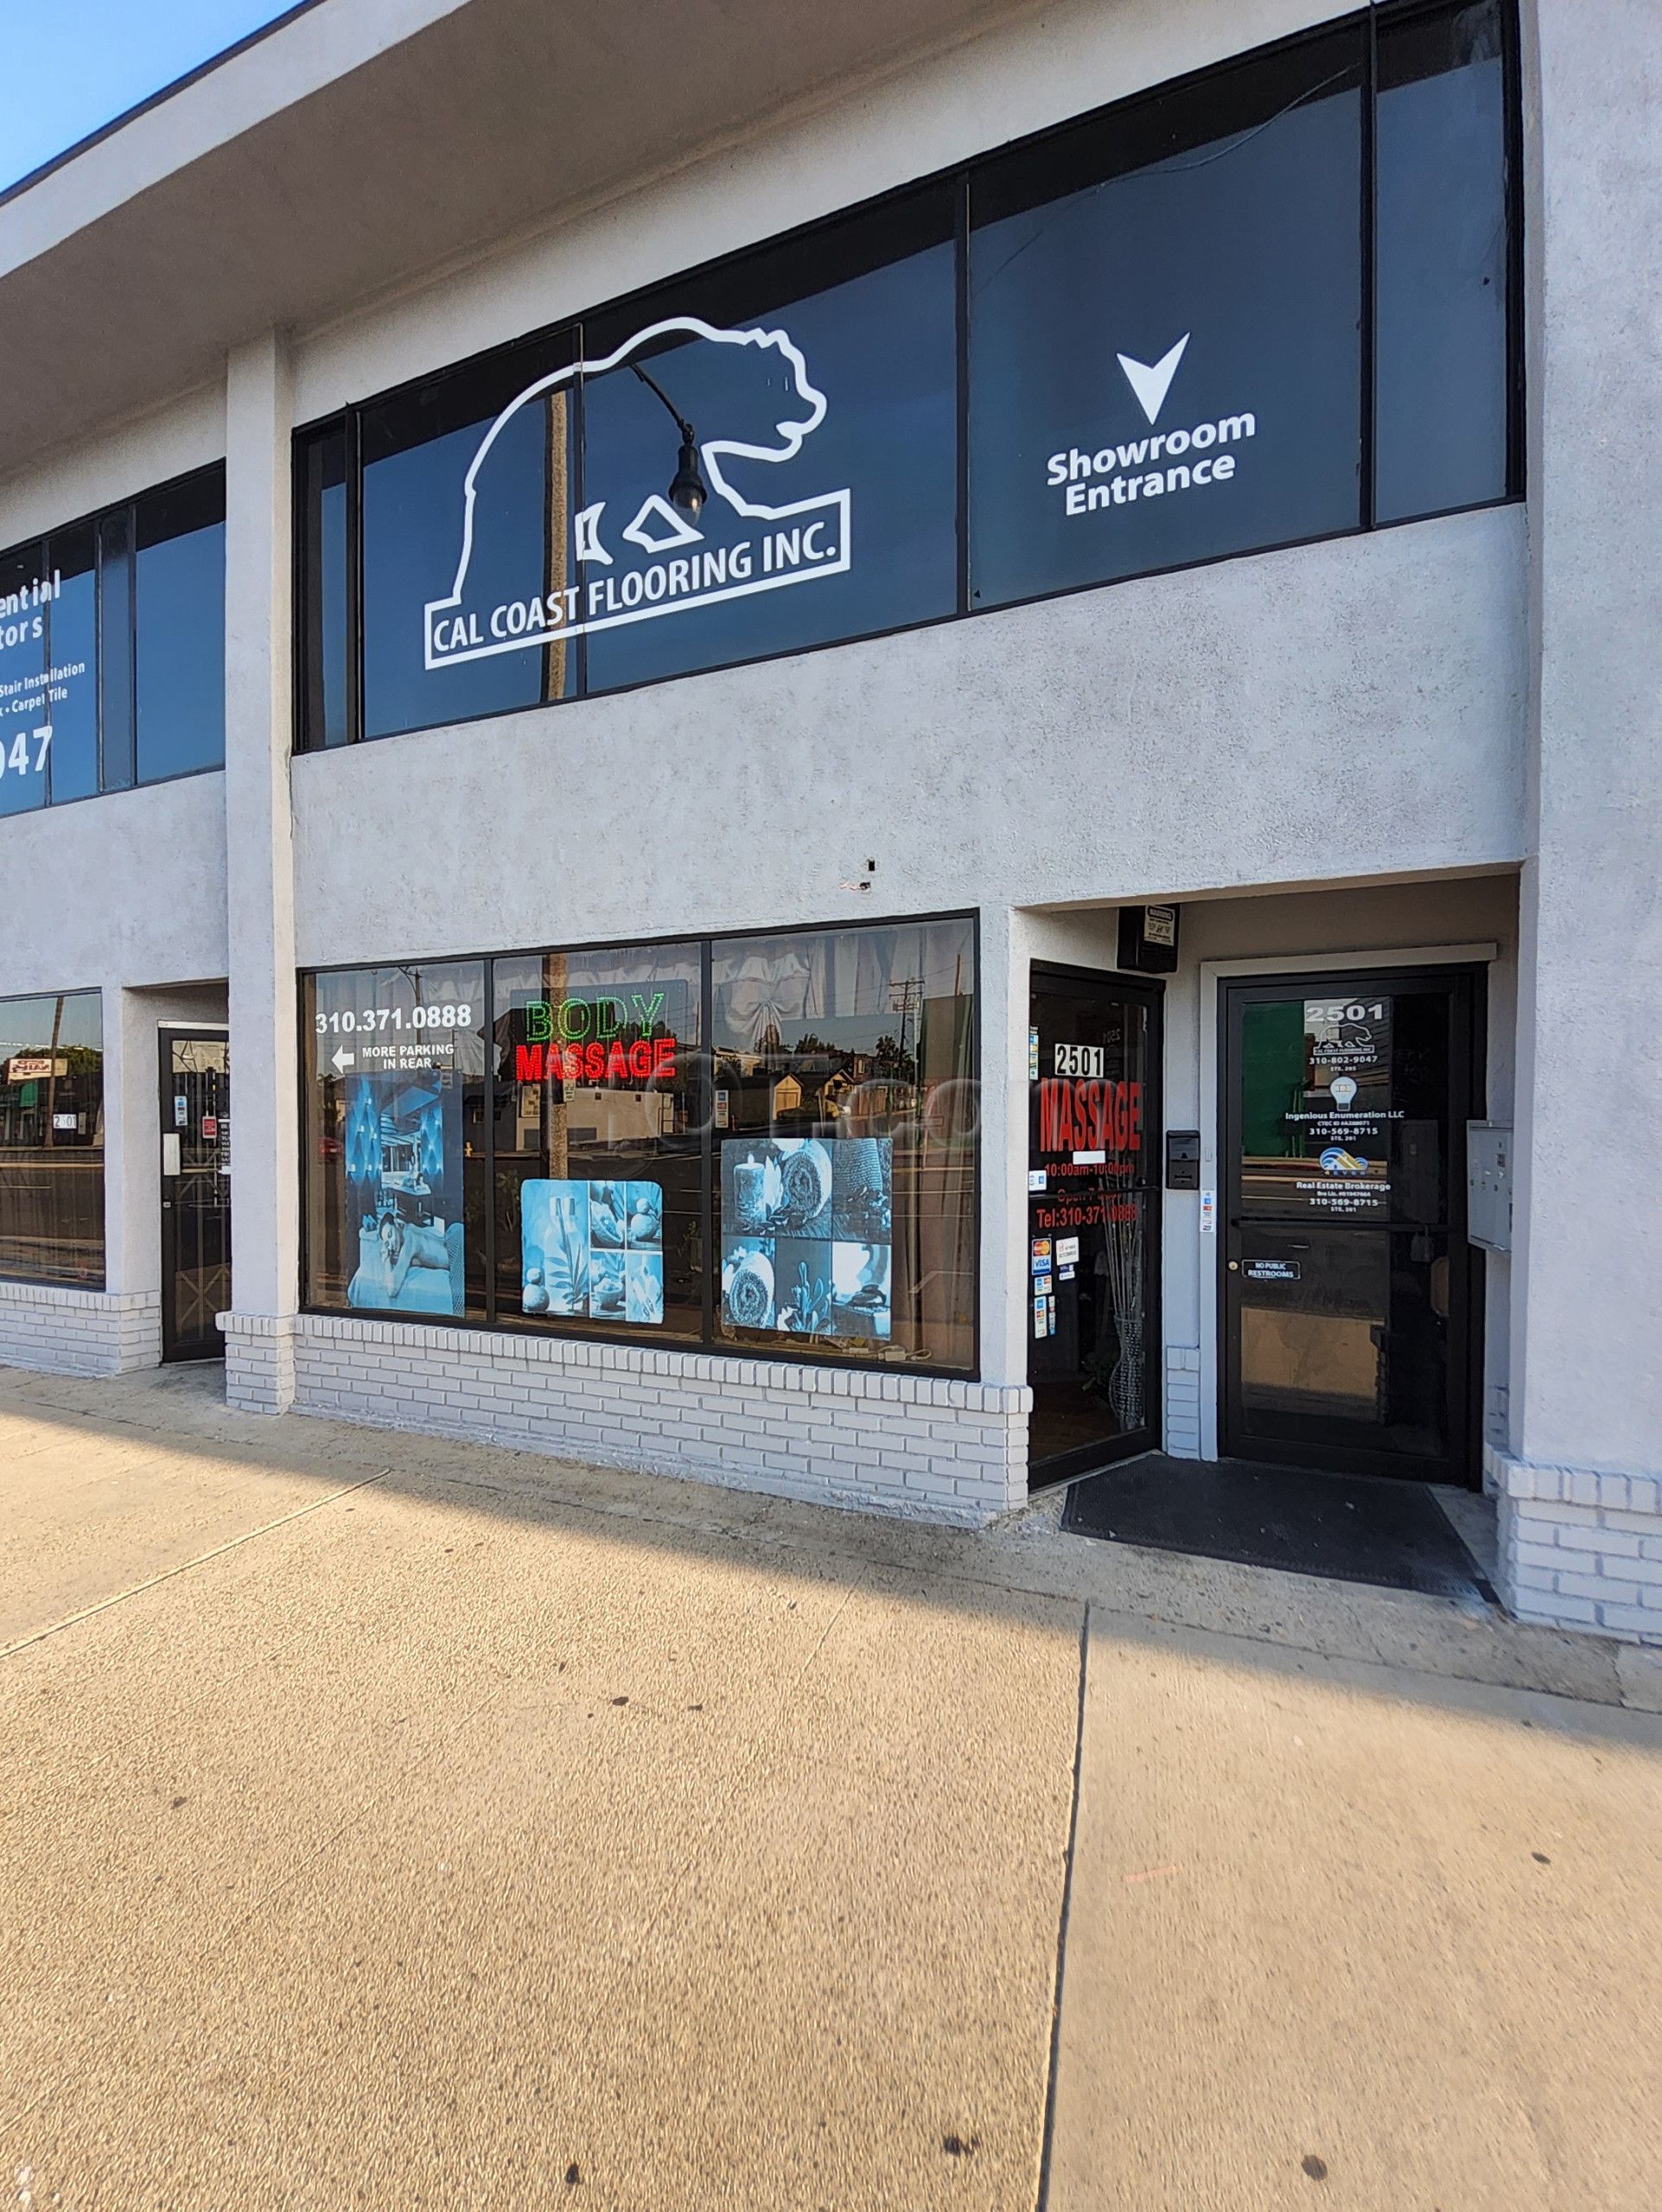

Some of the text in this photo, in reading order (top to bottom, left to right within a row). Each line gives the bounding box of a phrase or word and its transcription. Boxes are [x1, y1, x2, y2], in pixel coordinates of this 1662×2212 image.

[1047, 412, 1256, 486] Showroom
[1066, 454, 1236, 516] Entrance
[433, 521, 837, 652] CAL COAST FLOORING INC.
[24, 662, 86, 690] Installation
[48, 686, 68, 702] Tile
[0, 725, 53, 779] 47
[315, 1004, 472, 1034] 310.371.0888
[525, 992, 665, 1042] BODY
[1306, 1004, 1383, 1022] 2501
[361, 1044, 455, 1058] MORE PARKING
[515, 1038, 677, 1082] MASSAGE
[1309, 1055, 1379, 1065] 310-802-9047
[383, 1058, 432, 1071] IN REAR
[1056, 1045, 1101, 1077] 2501
[1040, 1077, 1141, 1153] MASSAGE
[1285, 1112, 1328, 1122] Ingenious
[1329, 1111, 1386, 1120] Enumeration
[1309, 1127, 1379, 1135] 310-569-8715
[1296, 1181, 1315, 1190] Real
[1345, 1181, 1391, 1192] Brokerage
[1309, 1198, 1379, 1206] 310-569-8715
[1035, 1258, 1049, 1268] VISA
[1247, 1269, 1294, 1278] RESTROOMS
